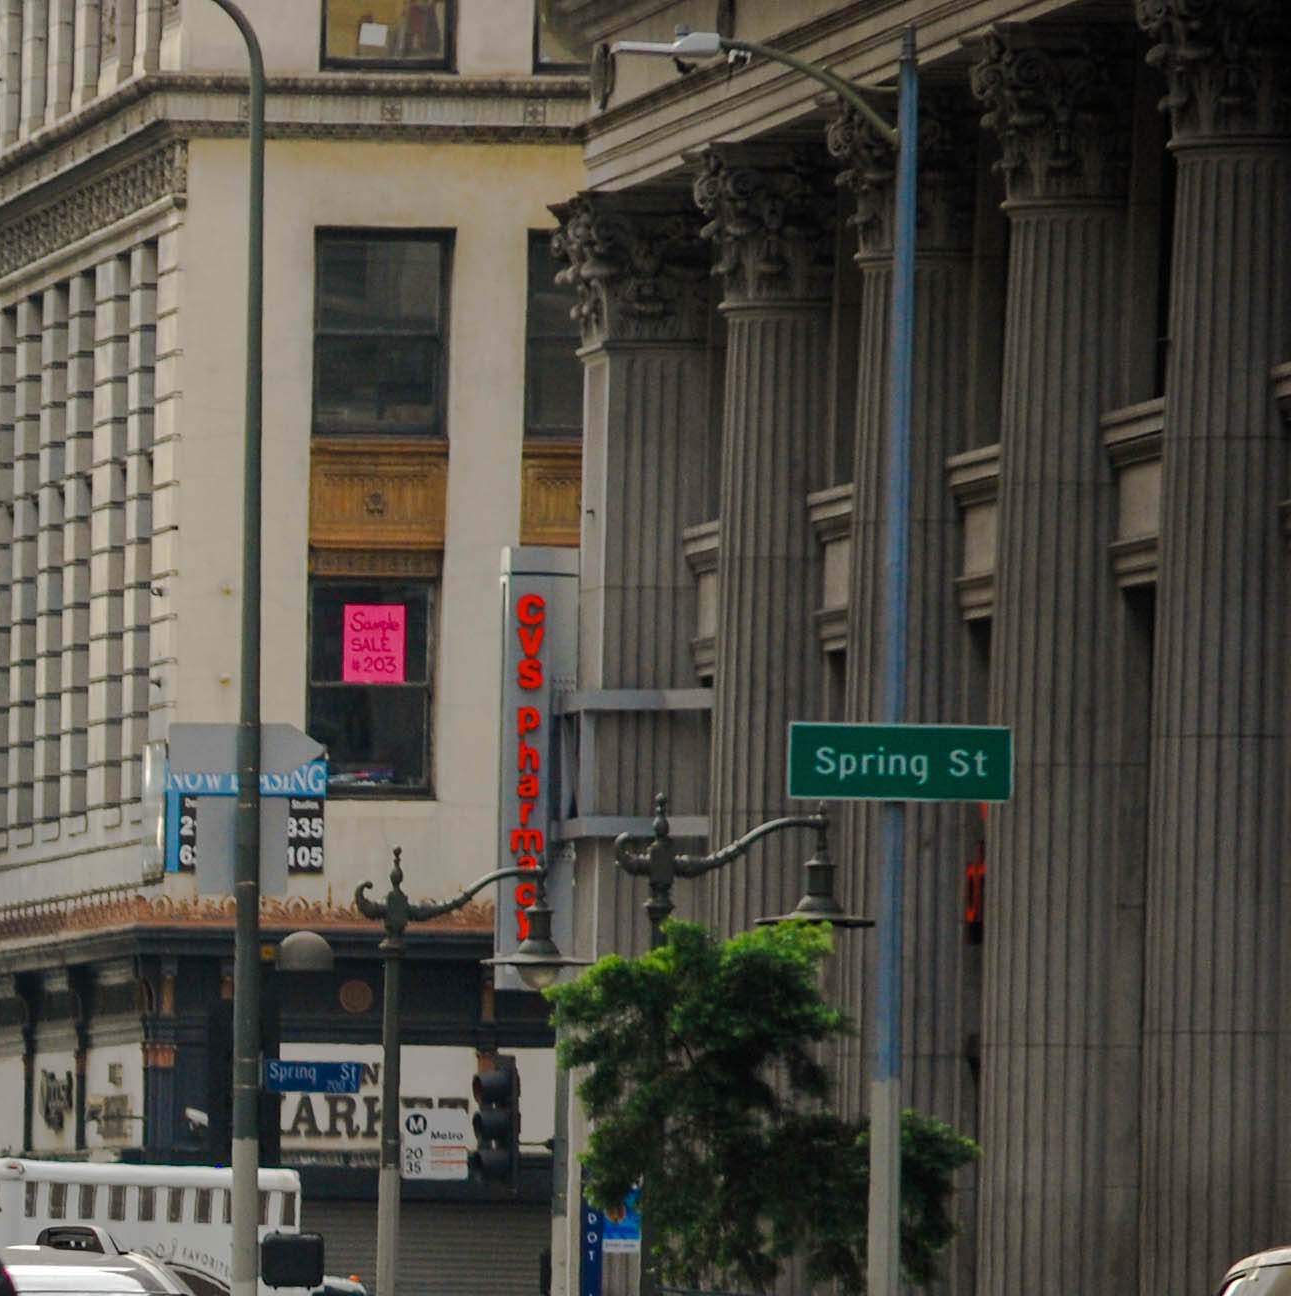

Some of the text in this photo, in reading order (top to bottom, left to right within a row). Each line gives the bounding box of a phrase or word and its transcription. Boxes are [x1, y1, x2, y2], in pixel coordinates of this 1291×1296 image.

[350, 611, 400, 638] Sample
[350, 636, 392, 653] SALE
[515, 593, 546, 690] CVS
[815, 746, 989, 785] Spring St
[268, 1063, 317, 1082] Spring
[340, 1064, 357, 1081] St
[430, 1130, 464, 1141] Metro
[405, 1147, 424, 1161] 20
[405, 1161, 422, 1175] 35
